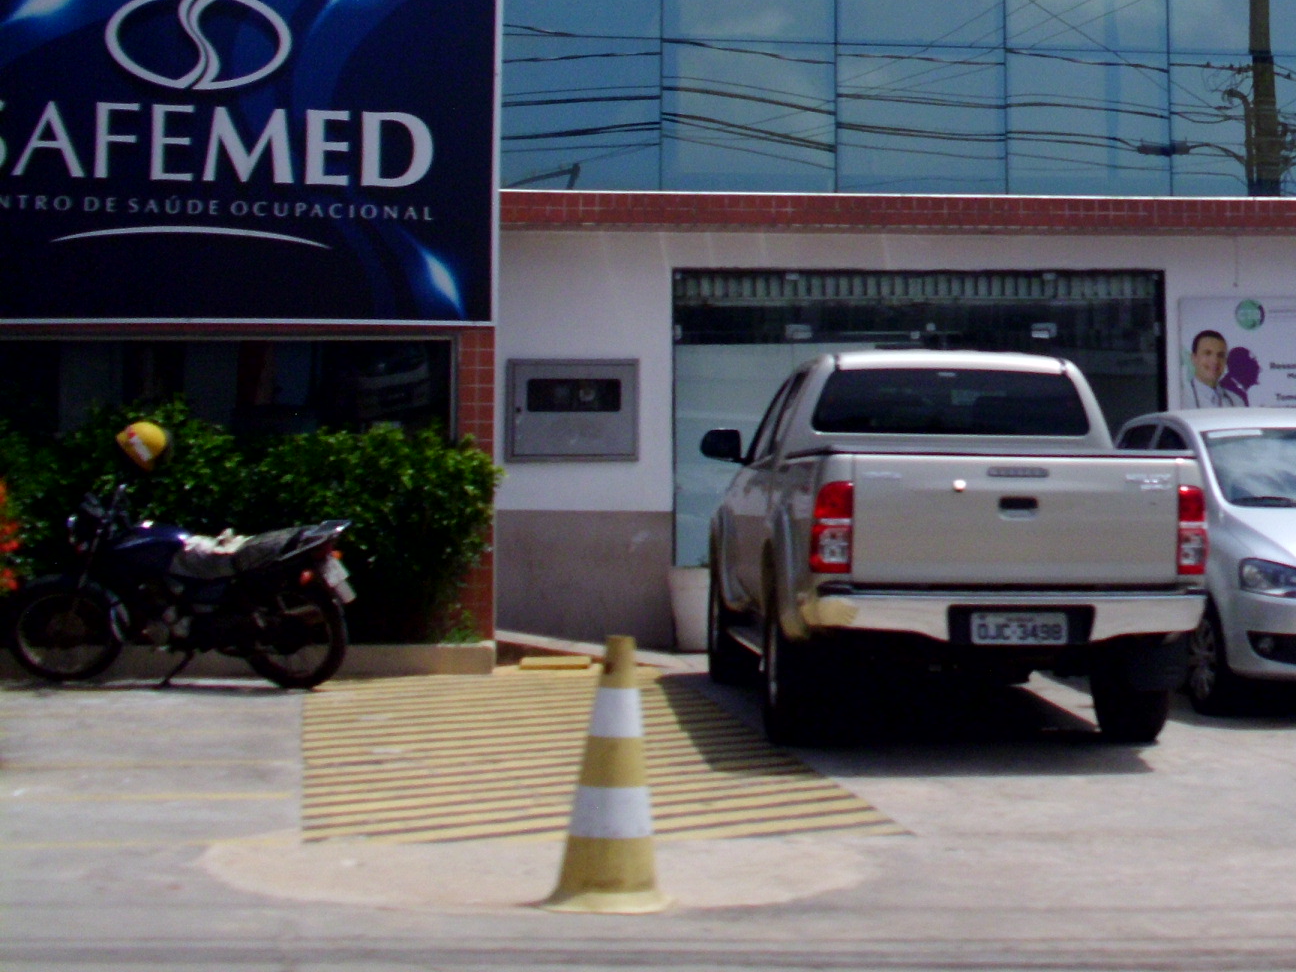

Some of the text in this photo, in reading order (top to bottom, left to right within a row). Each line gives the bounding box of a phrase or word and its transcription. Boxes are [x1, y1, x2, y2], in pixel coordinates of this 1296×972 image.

[0, 100, 435, 188] AFEMED
[83, 195, 118, 213] DE
[127, 195, 220, 215] SAÚDE
[229, 199, 434, 221] OCUPACIONAL
